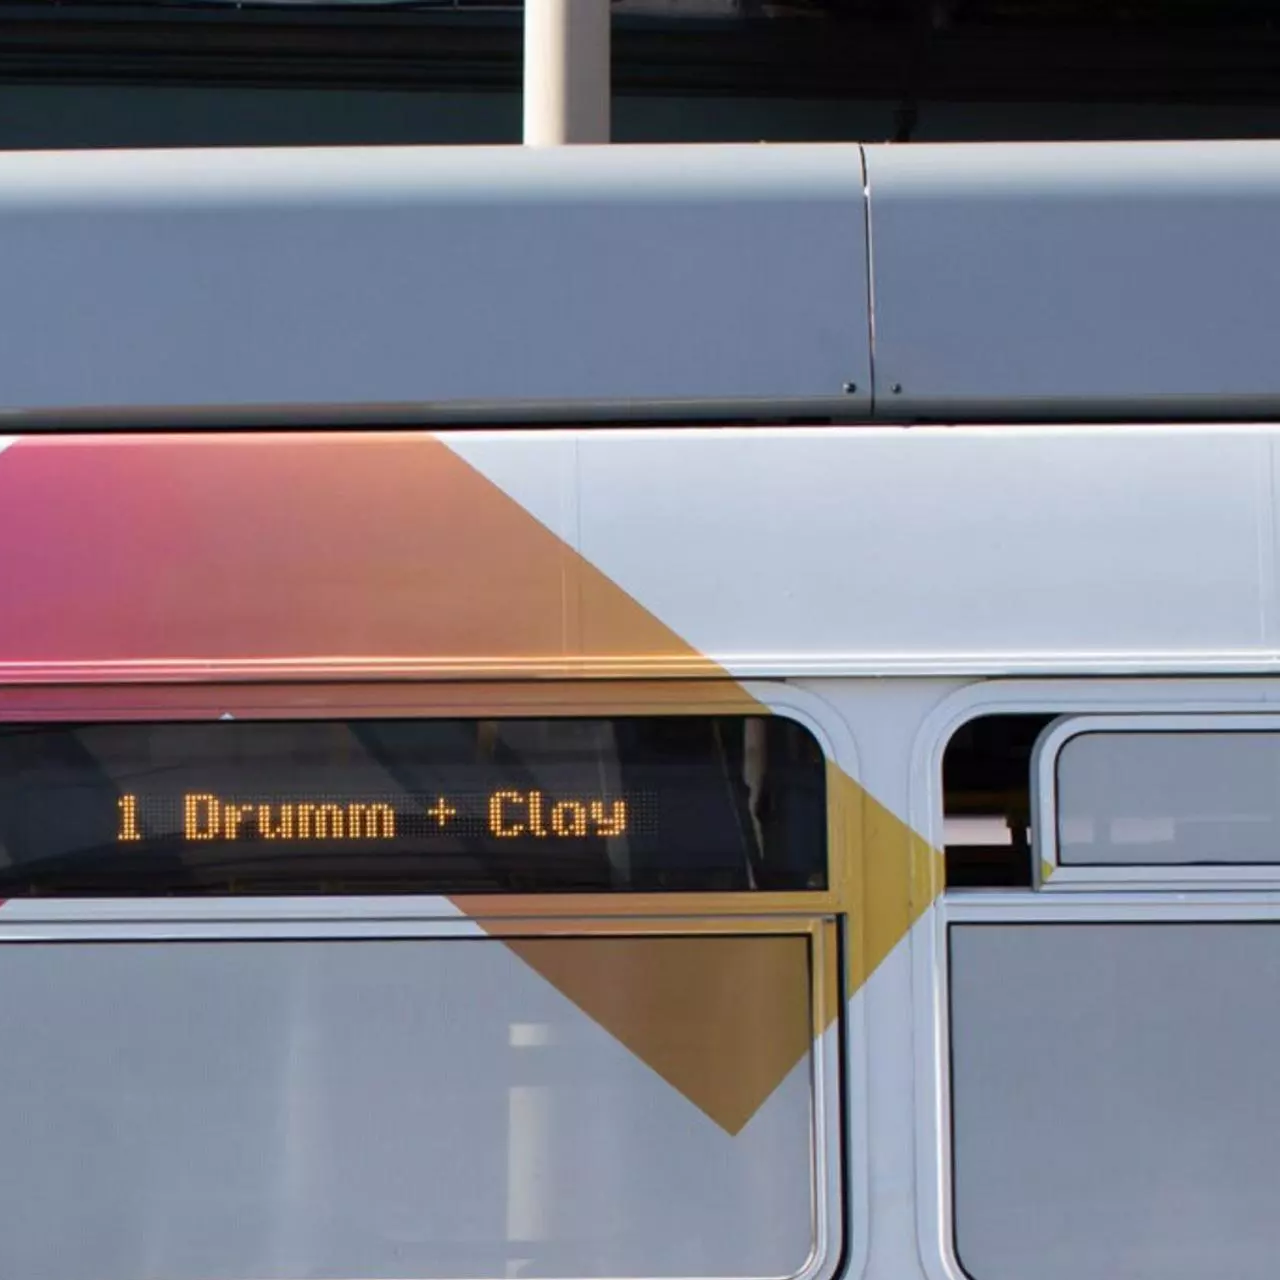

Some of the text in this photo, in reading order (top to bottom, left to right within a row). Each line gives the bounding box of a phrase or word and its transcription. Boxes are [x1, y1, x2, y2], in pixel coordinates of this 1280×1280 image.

[117, 794, 141, 840] 1
[184, 793, 395, 840] Drumm
[489, 790, 626, 837] Clay
